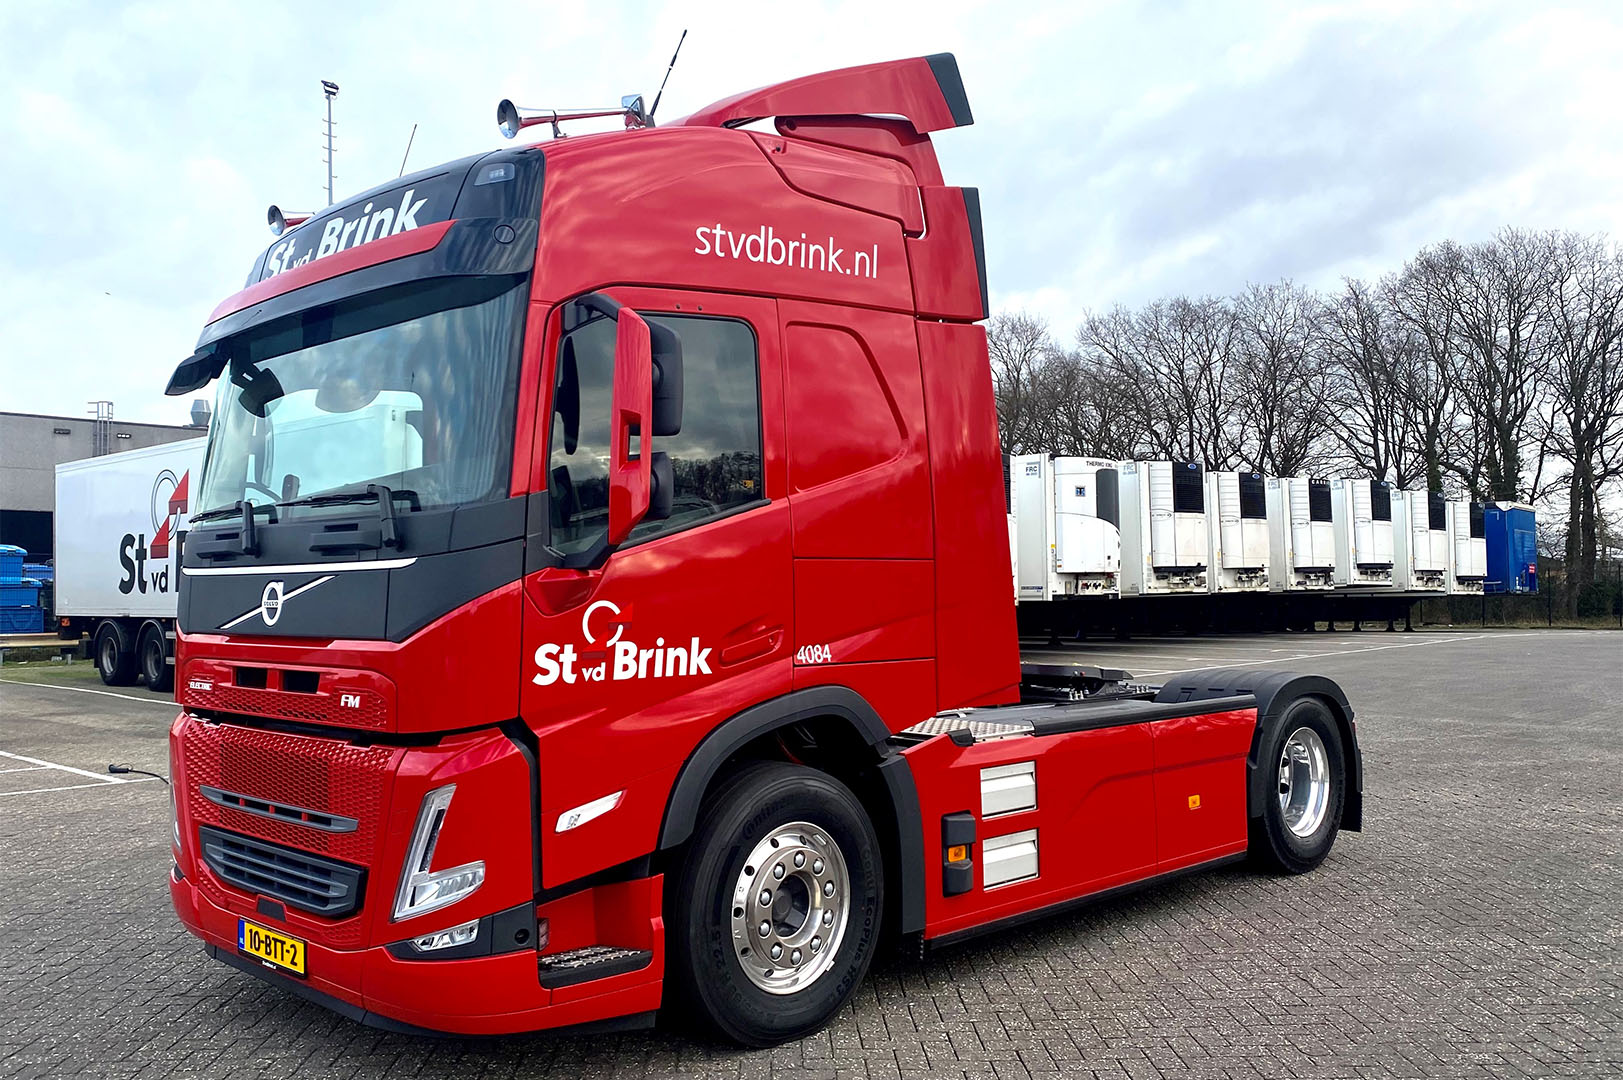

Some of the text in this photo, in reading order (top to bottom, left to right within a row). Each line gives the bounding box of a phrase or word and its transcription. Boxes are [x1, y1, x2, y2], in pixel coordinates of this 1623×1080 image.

[266, 189, 428, 279] St vd Brink
[694, 223, 878, 279] stvdbrink.nl
[118, 533, 148, 595] St
[151, 564, 169, 593] vd
[532, 636, 713, 686] St vd Brink
[796, 643, 832, 664] 4084
[189, 681, 213, 691] ELECTRIC
[340, 694, 361, 709] FM
[249, 928, 298, 967] 10-BTT-2
